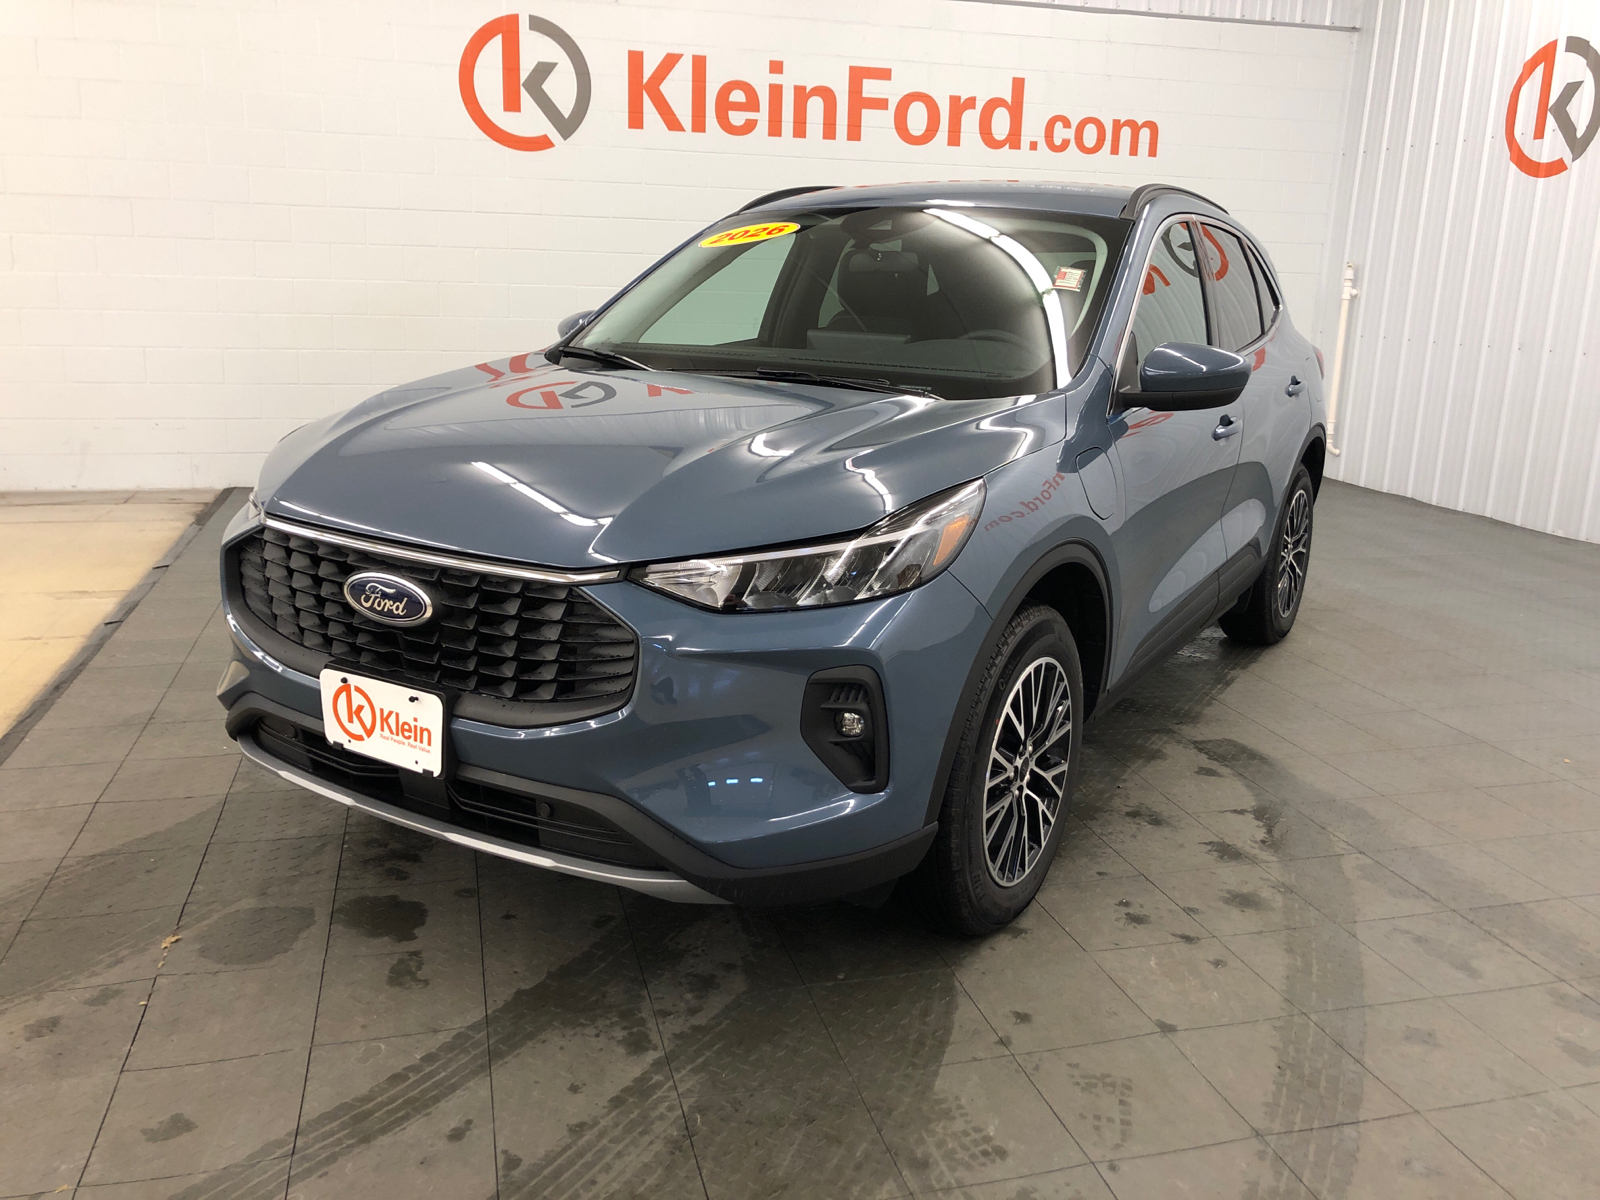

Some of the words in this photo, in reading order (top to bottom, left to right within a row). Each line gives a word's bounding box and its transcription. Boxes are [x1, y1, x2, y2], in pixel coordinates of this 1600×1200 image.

[627, 49, 1160, 158] KleinFord.com
[709, 224, 790, 244] 2026
[361, 583, 407, 615] Ford
[379, 707, 432, 747] Klein
